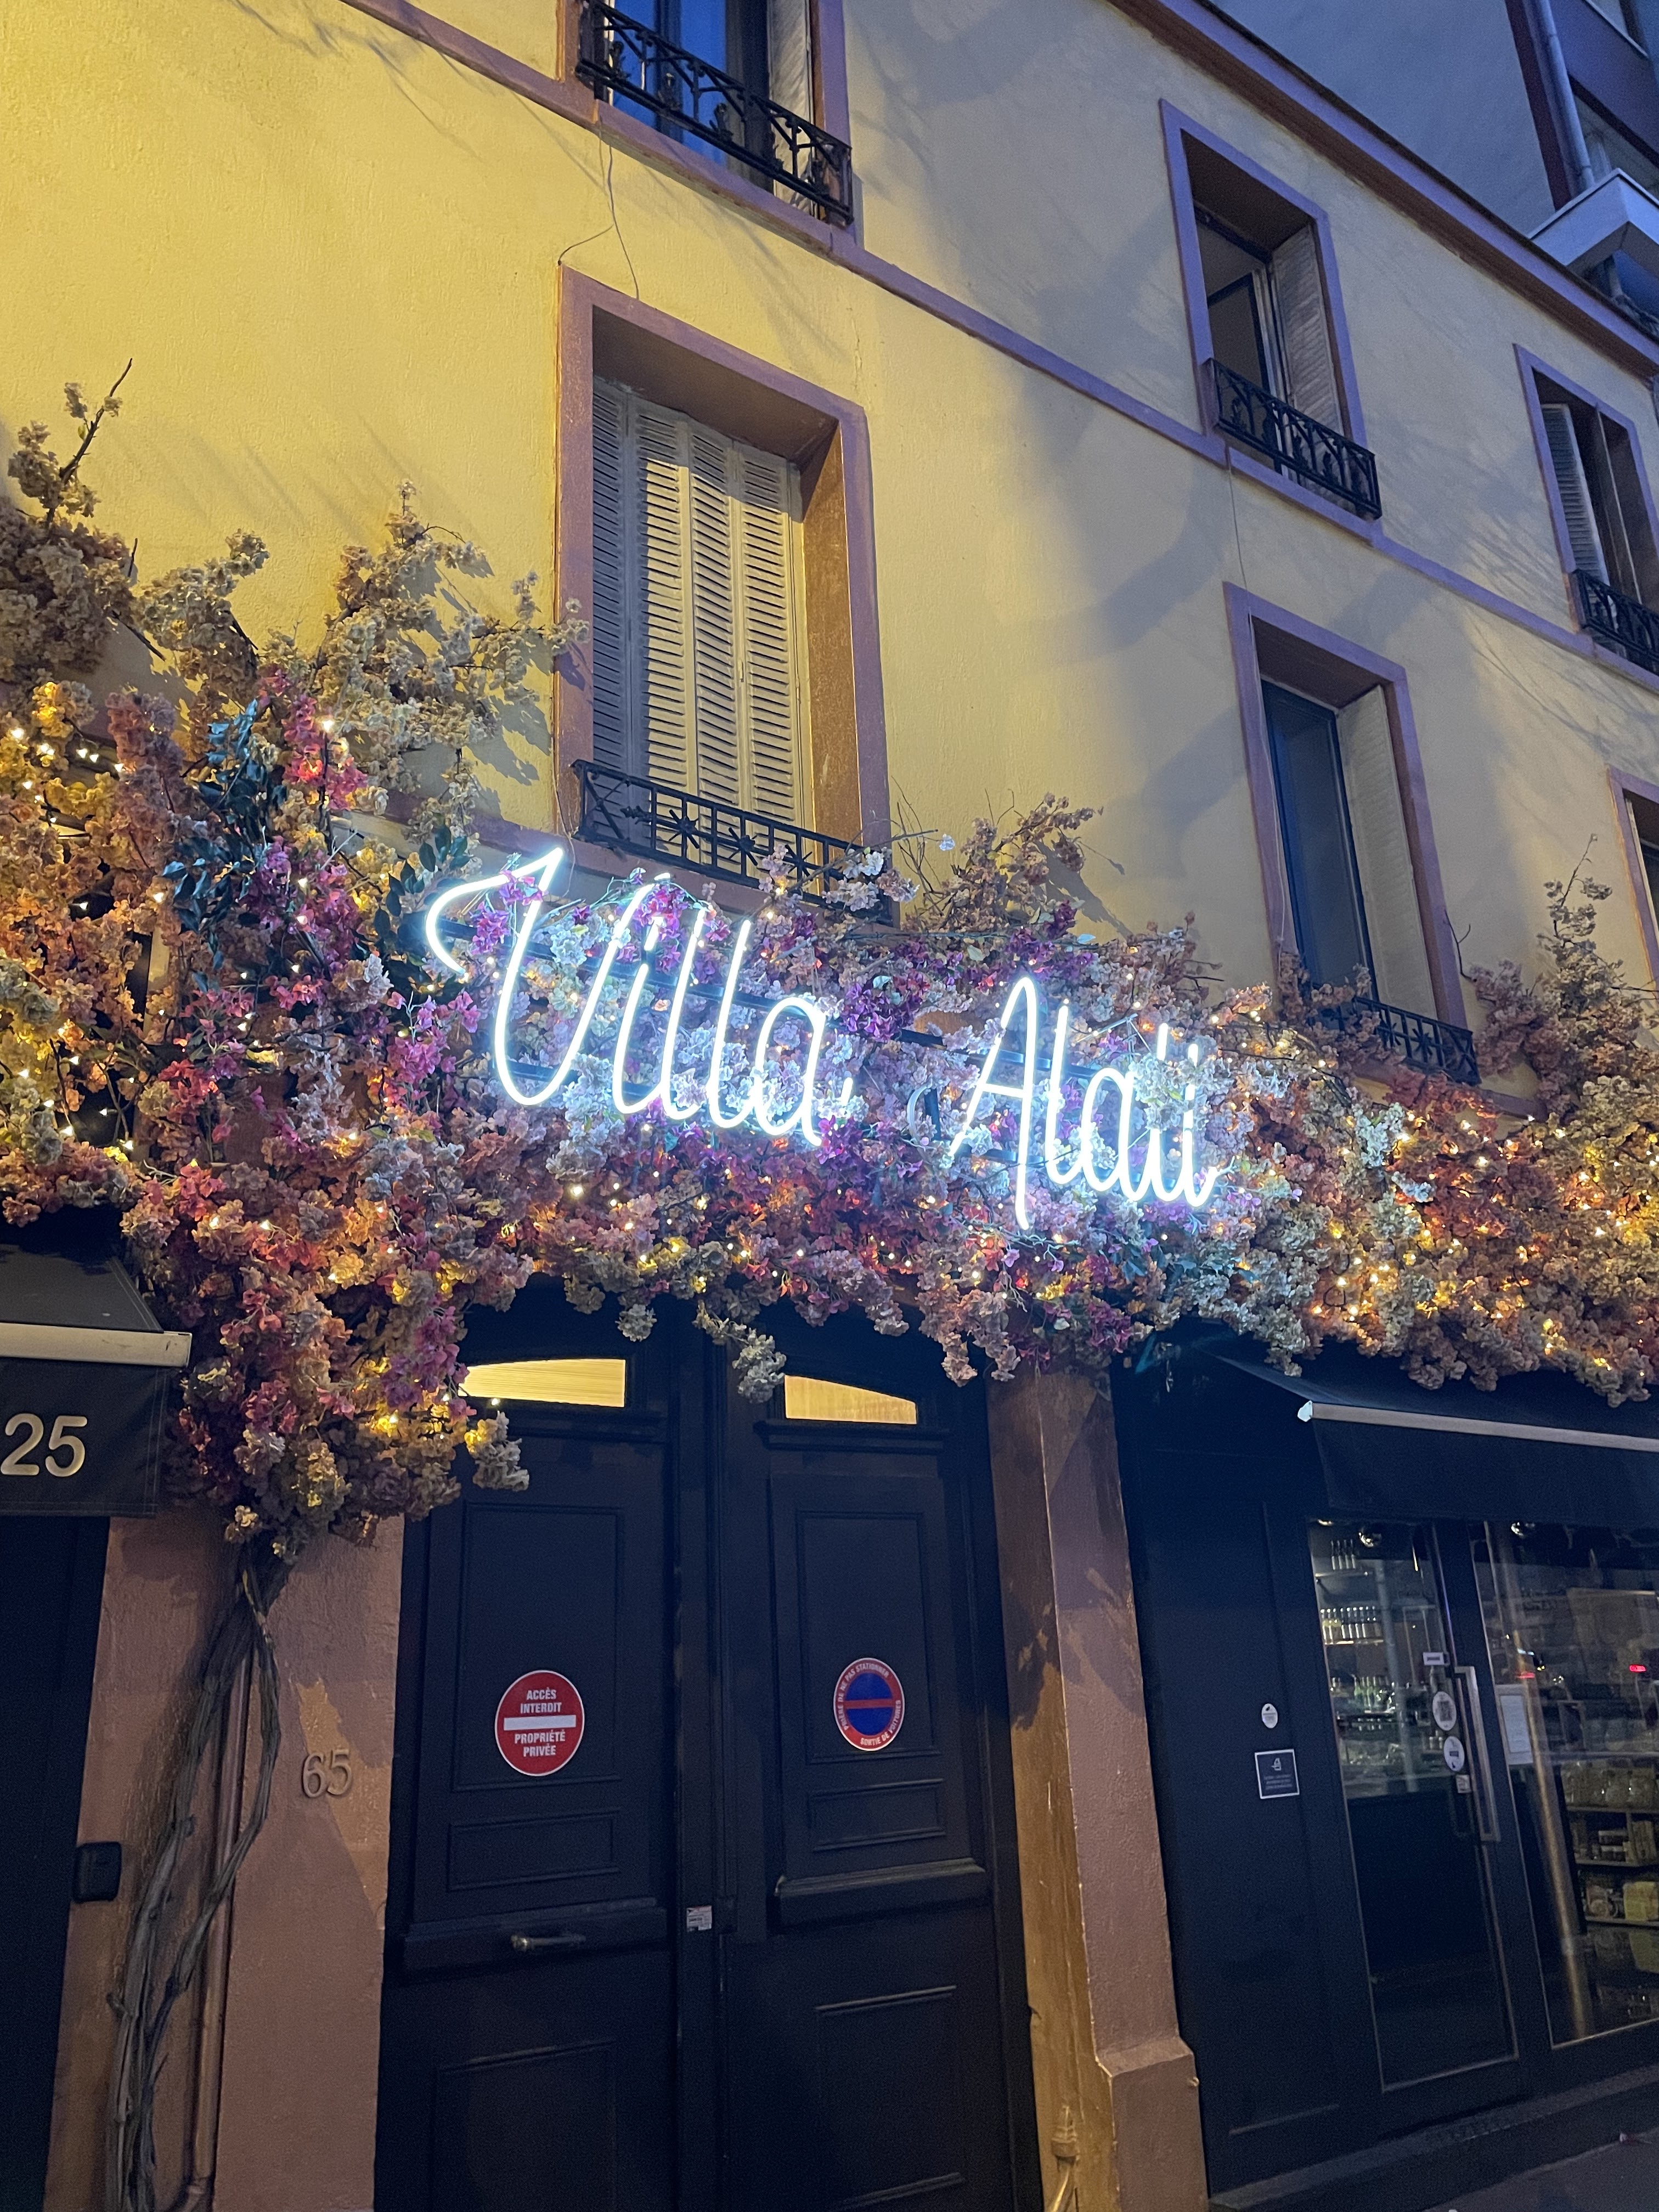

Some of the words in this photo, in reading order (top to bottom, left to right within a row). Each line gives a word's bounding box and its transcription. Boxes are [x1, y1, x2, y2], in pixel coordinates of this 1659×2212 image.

[425, 847, 854, 1147] Villa
[1, 1413, 88, 1477] 25
[837, 1692, 844, 1702] DE
[845, 1668, 856, 1682] PAS
[526, 1686, 557, 1700] ACCÈS
[520, 1702, 562, 1714] INTERDIT
[514, 1729, 566, 1744] PROPRIÉTÉ
[860, 1737, 882, 1746] SORTIE
[881, 1731, 890, 1741] DE
[523, 1742, 556, 1757] PRIVÉE
[302, 1748, 353, 1798] 65
